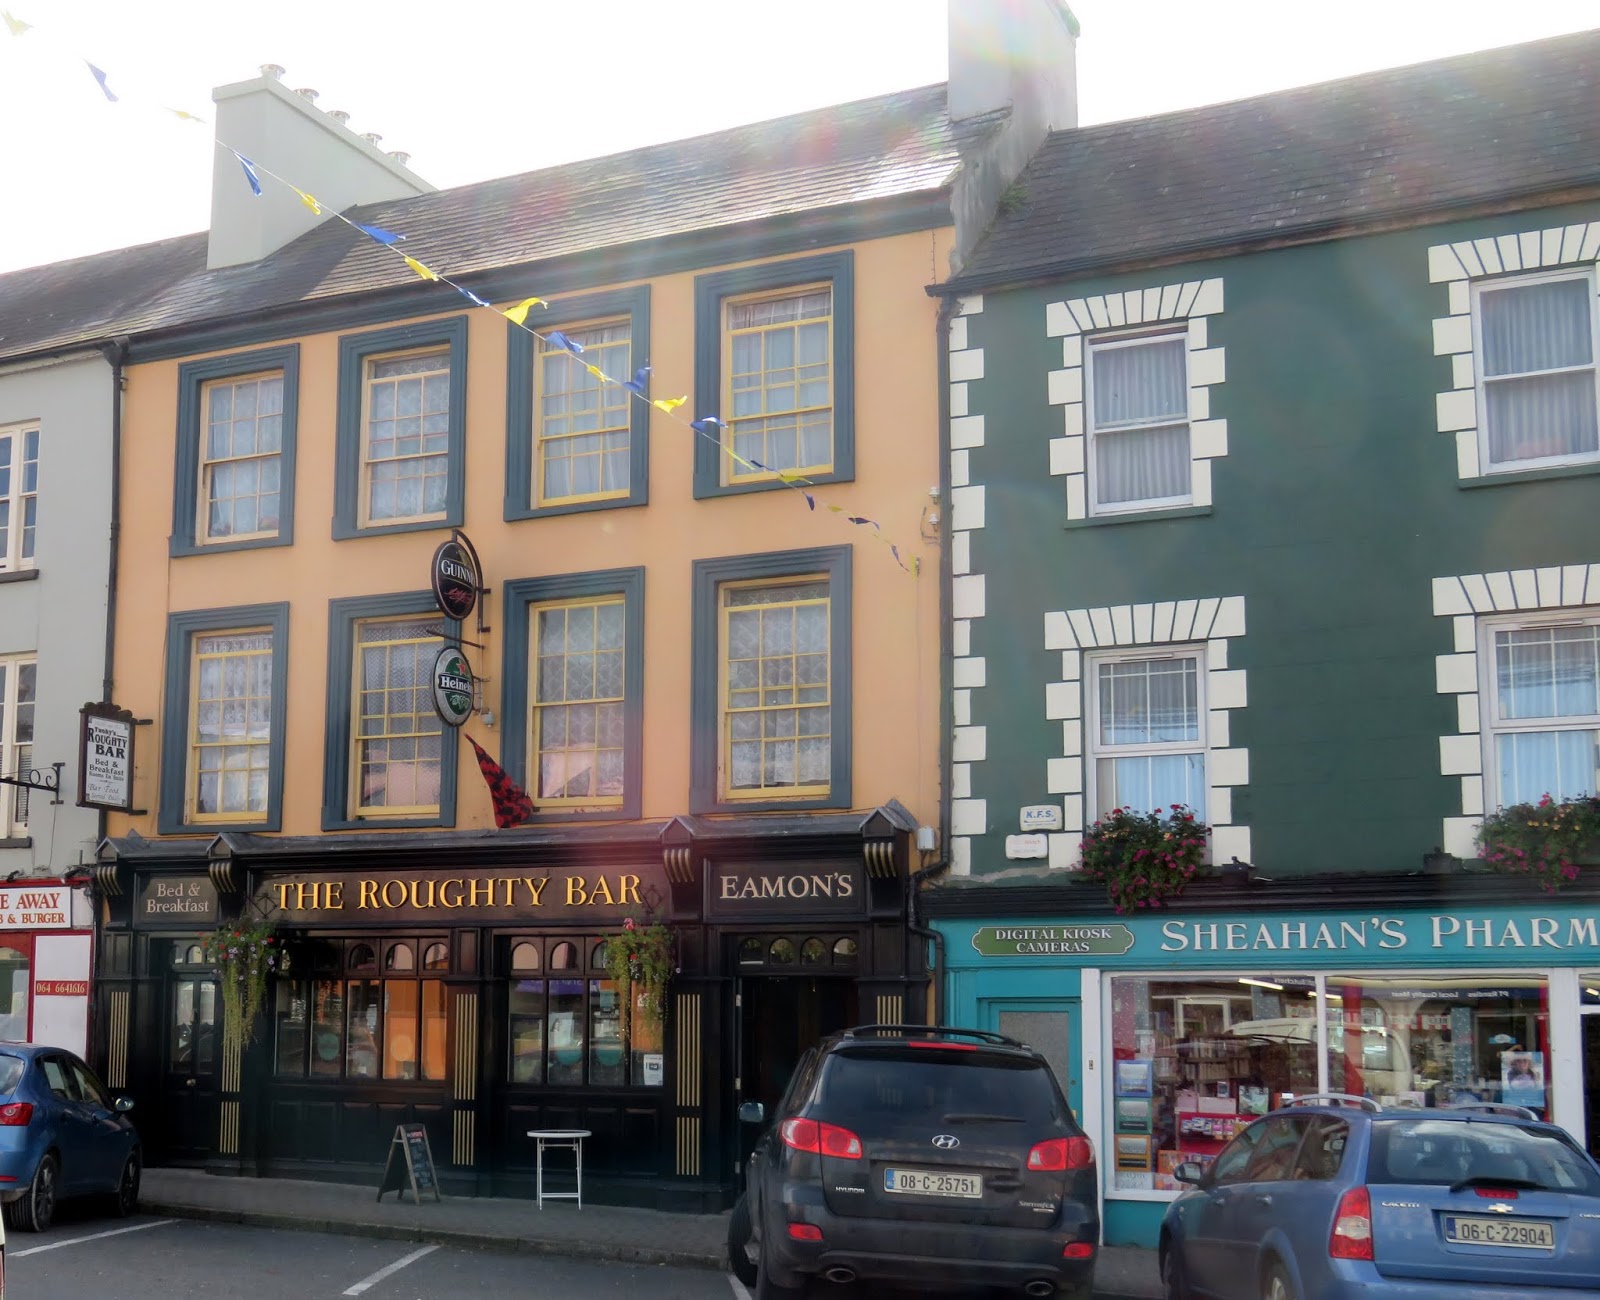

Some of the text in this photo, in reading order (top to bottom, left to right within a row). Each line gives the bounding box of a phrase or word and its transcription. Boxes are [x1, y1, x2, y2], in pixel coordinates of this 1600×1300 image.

[441, 559, 476, 584] GUINN
[88, 728, 127, 748] ROUGHTY
[95, 744, 125, 759] BAR
[95, 758, 108, 766] Bed
[90, 764, 124, 776] Breakfast
[1026, 810, 1054, 818] K.F.S.
[157, 882, 200, 897] Bed &
[274, 874, 643, 910] THE ROUGHTY BAR
[720, 872, 853, 899] EAMON'S
[16, 893, 60, 909] AWAY
[147, 899, 209, 913] Breakfast
[8, 914, 16, 923] &
[21, 913, 65, 924] BURGER
[996, 928, 1112, 940] DIGITAL KIOSK
[1160, 916, 1600, 951] SHEAHAN'S PHARM
[1016, 942, 1090, 953] CAMERAS
[37, 984, 51, 993] 064
[900, 1174, 975, 1193] 08-C-25751
[1461, 1223, 1546, 1244] 06-C-22904
